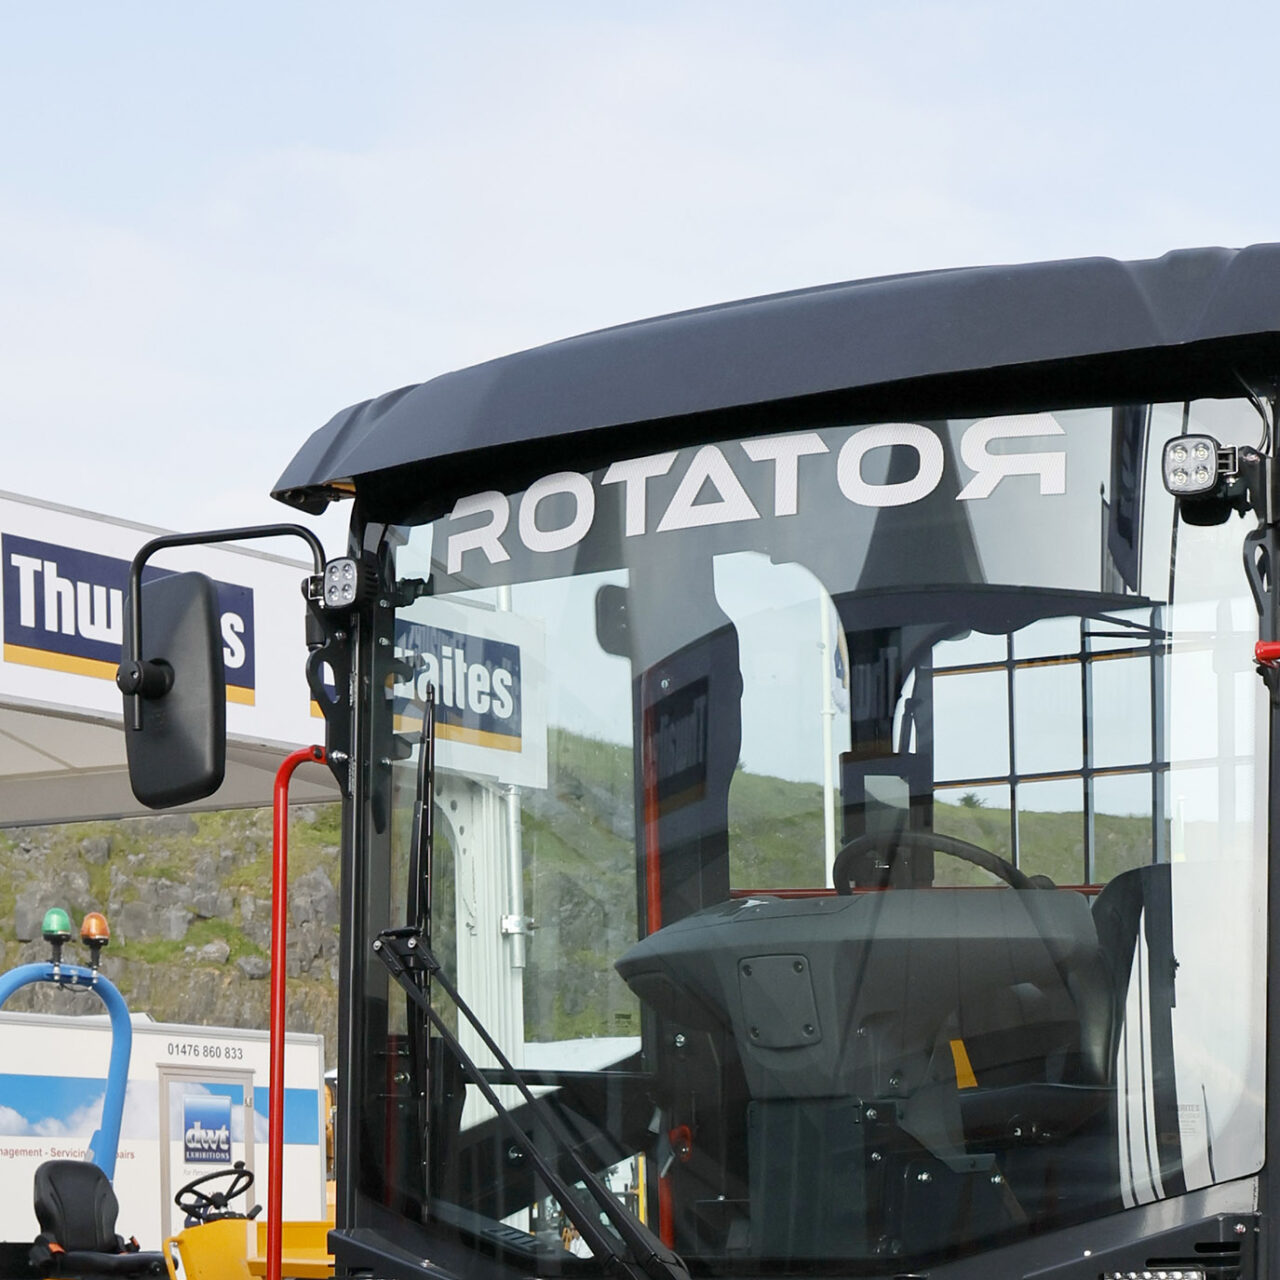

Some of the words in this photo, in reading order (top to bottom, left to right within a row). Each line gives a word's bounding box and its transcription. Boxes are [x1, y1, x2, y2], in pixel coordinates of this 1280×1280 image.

[447, 412, 1066, 575] ROTATOR
[10, 553, 246, 669] Thws
[167, 1043, 200, 1058] 01476
[202, 1045, 222, 1059] 860
[224, 1047, 244, 1060] 833
[185, 1122, 230, 1150] dwt
[50, 1147, 86, 1159] Servicin
[186, 1151, 230, 1161] EXHIBITIONS
